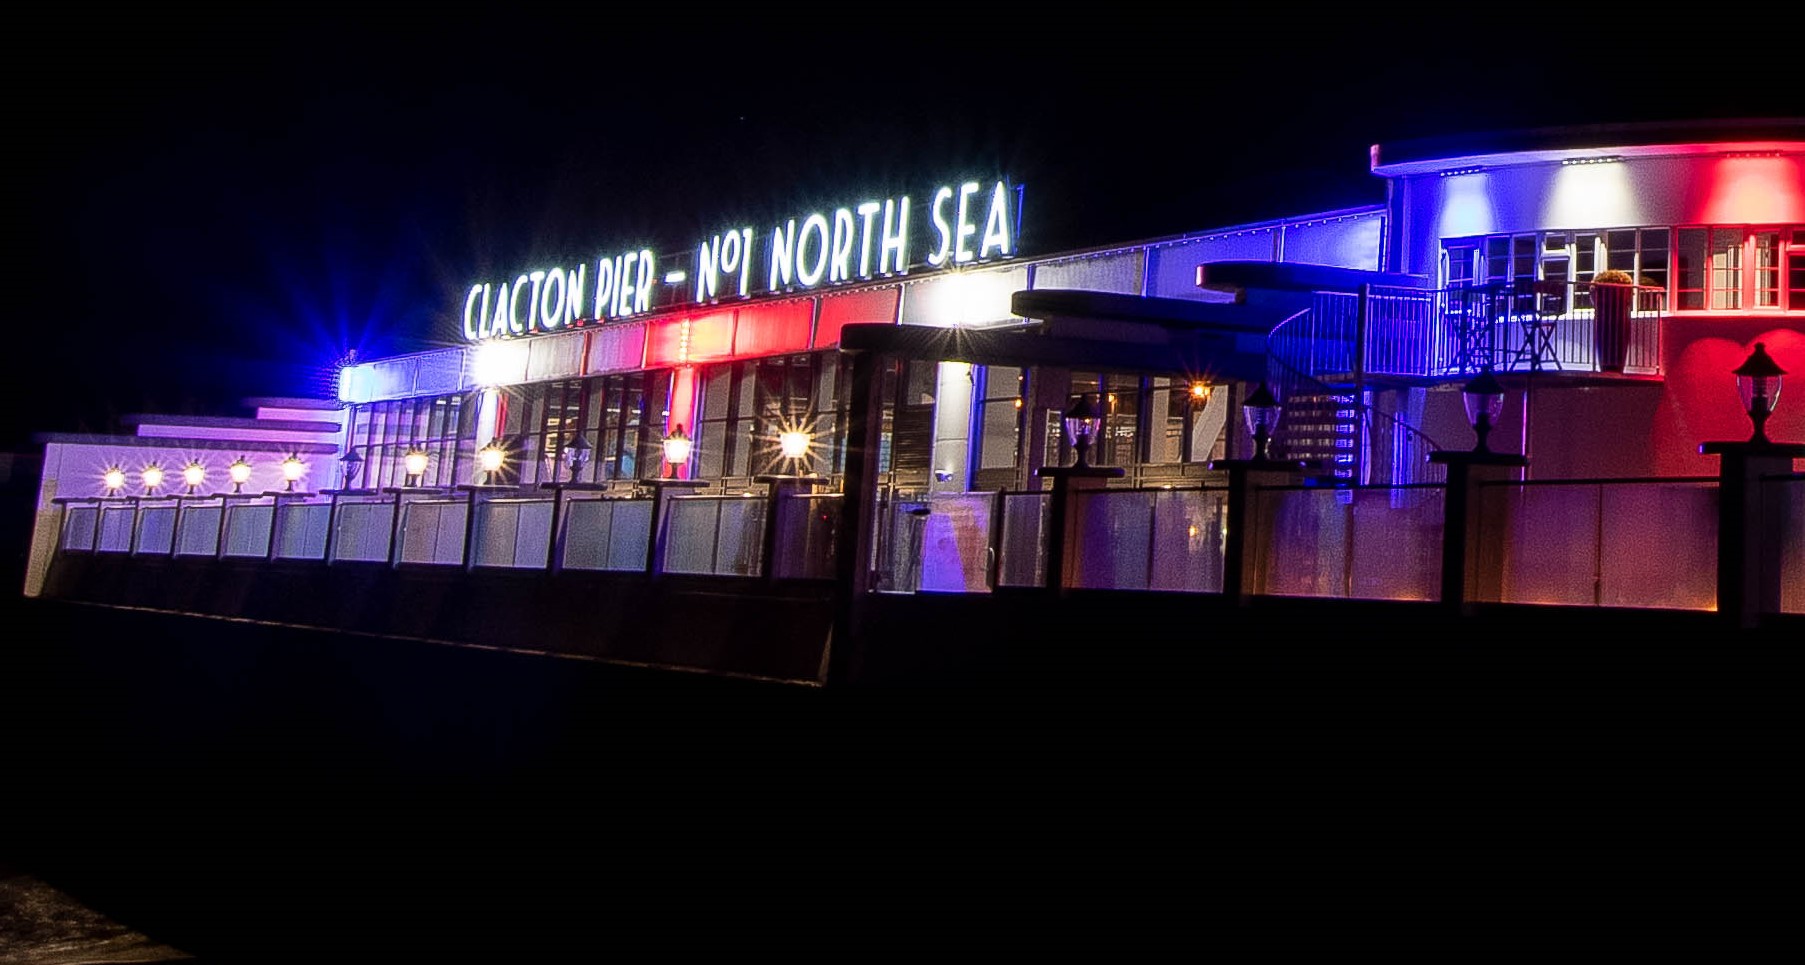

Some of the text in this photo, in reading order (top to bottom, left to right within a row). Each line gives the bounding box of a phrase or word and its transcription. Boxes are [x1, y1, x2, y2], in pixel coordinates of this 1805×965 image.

[463, 264, 585, 340] CLACTON
[594, 249, 655, 320] PIER
[769, 196, 910, 291] NORTH
[927, 181, 1010, 266] SEA
